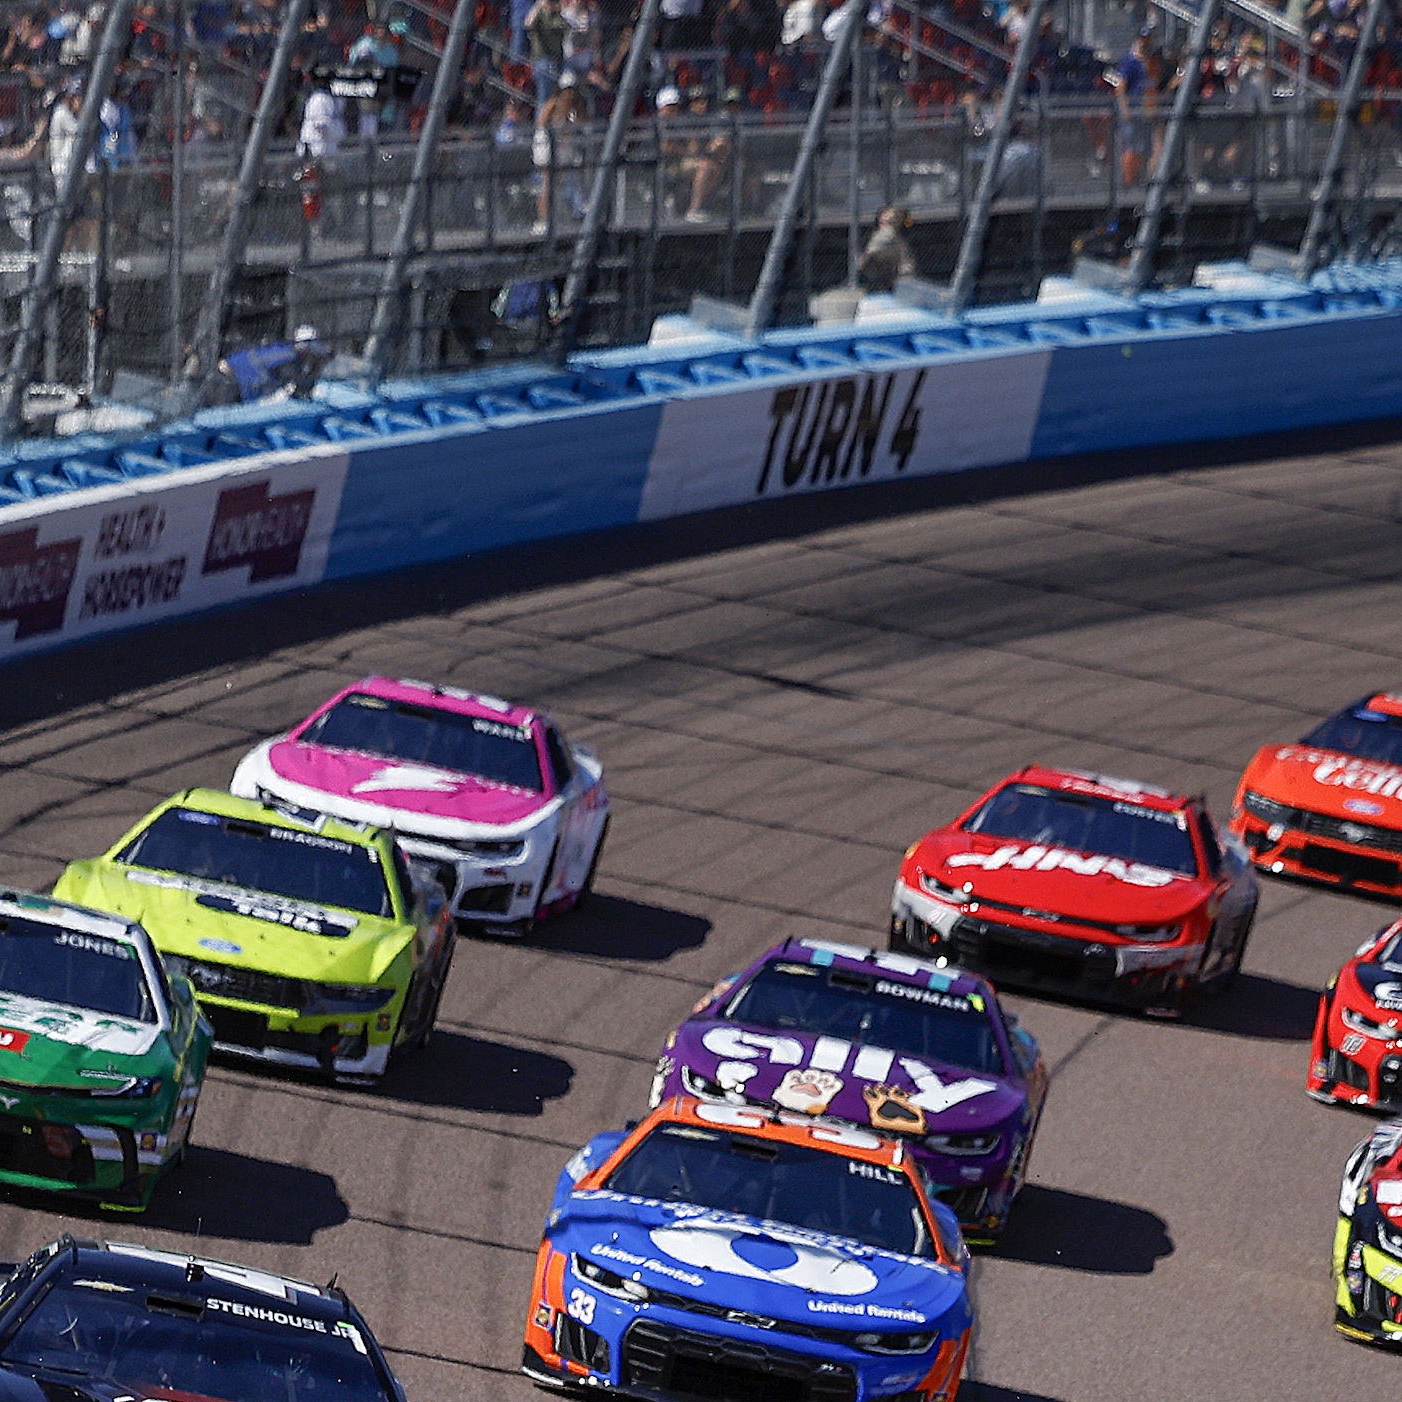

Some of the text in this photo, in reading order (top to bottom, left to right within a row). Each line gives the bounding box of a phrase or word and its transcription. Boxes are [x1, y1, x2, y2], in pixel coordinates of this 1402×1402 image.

[757, 366, 928, 494] TURN 4
[874, 980, 971, 1013] BOWMAN
[848, 1161, 903, 1187] HILL
[206, 1297, 327, 1335] STENHOUSE
[566, 1287, 598, 1327] 33
